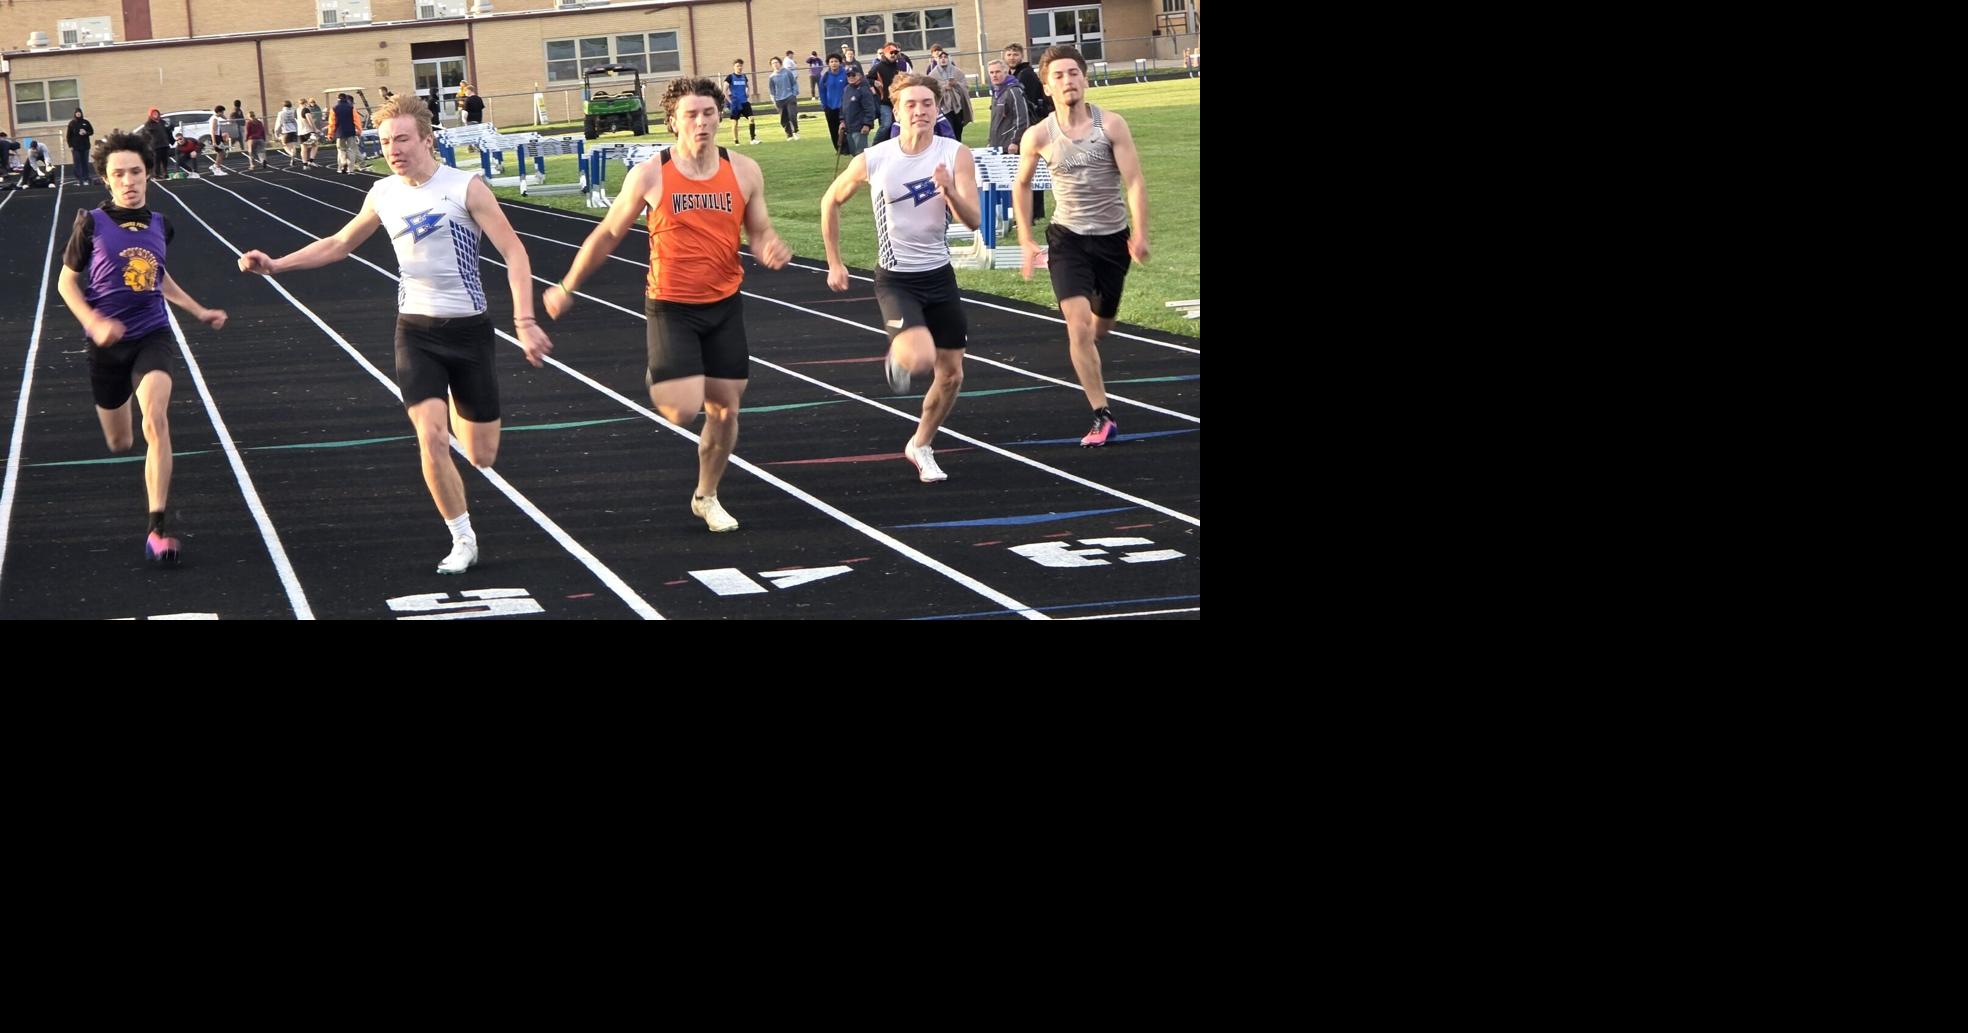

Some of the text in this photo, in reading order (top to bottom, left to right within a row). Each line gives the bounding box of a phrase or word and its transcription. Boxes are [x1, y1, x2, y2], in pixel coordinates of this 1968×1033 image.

[671, 192, 733, 215] WESTVILLE
[1007, 537, 1187, 568] 3
[687, 565, 855, 596] 4
[385, 588, 546, 620] 5
